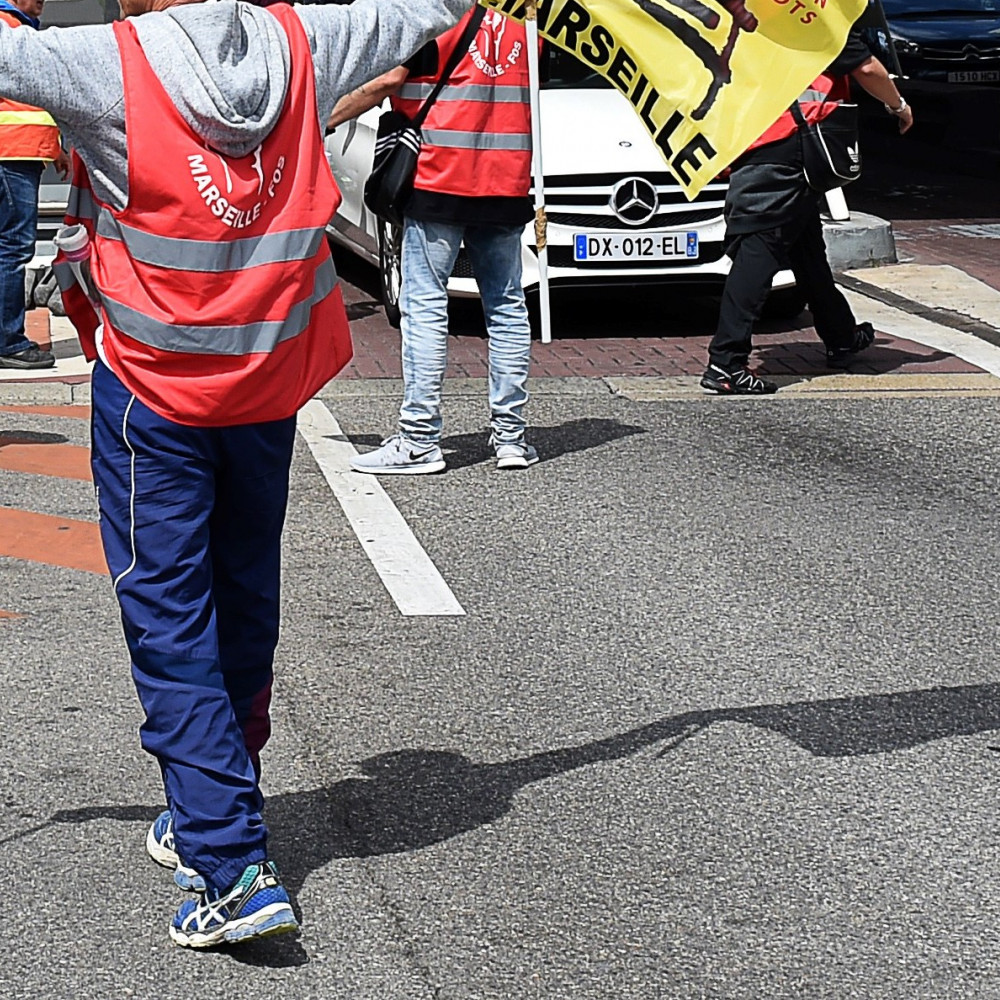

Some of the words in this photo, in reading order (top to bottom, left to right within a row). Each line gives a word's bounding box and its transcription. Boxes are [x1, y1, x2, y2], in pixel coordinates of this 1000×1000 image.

[507, 41, 522, 65] FOS
[187, 154, 262, 229] MARSEILLE
[268, 156, 286, 198] FOS
[588, 236, 686, 257] DX-012-EL
